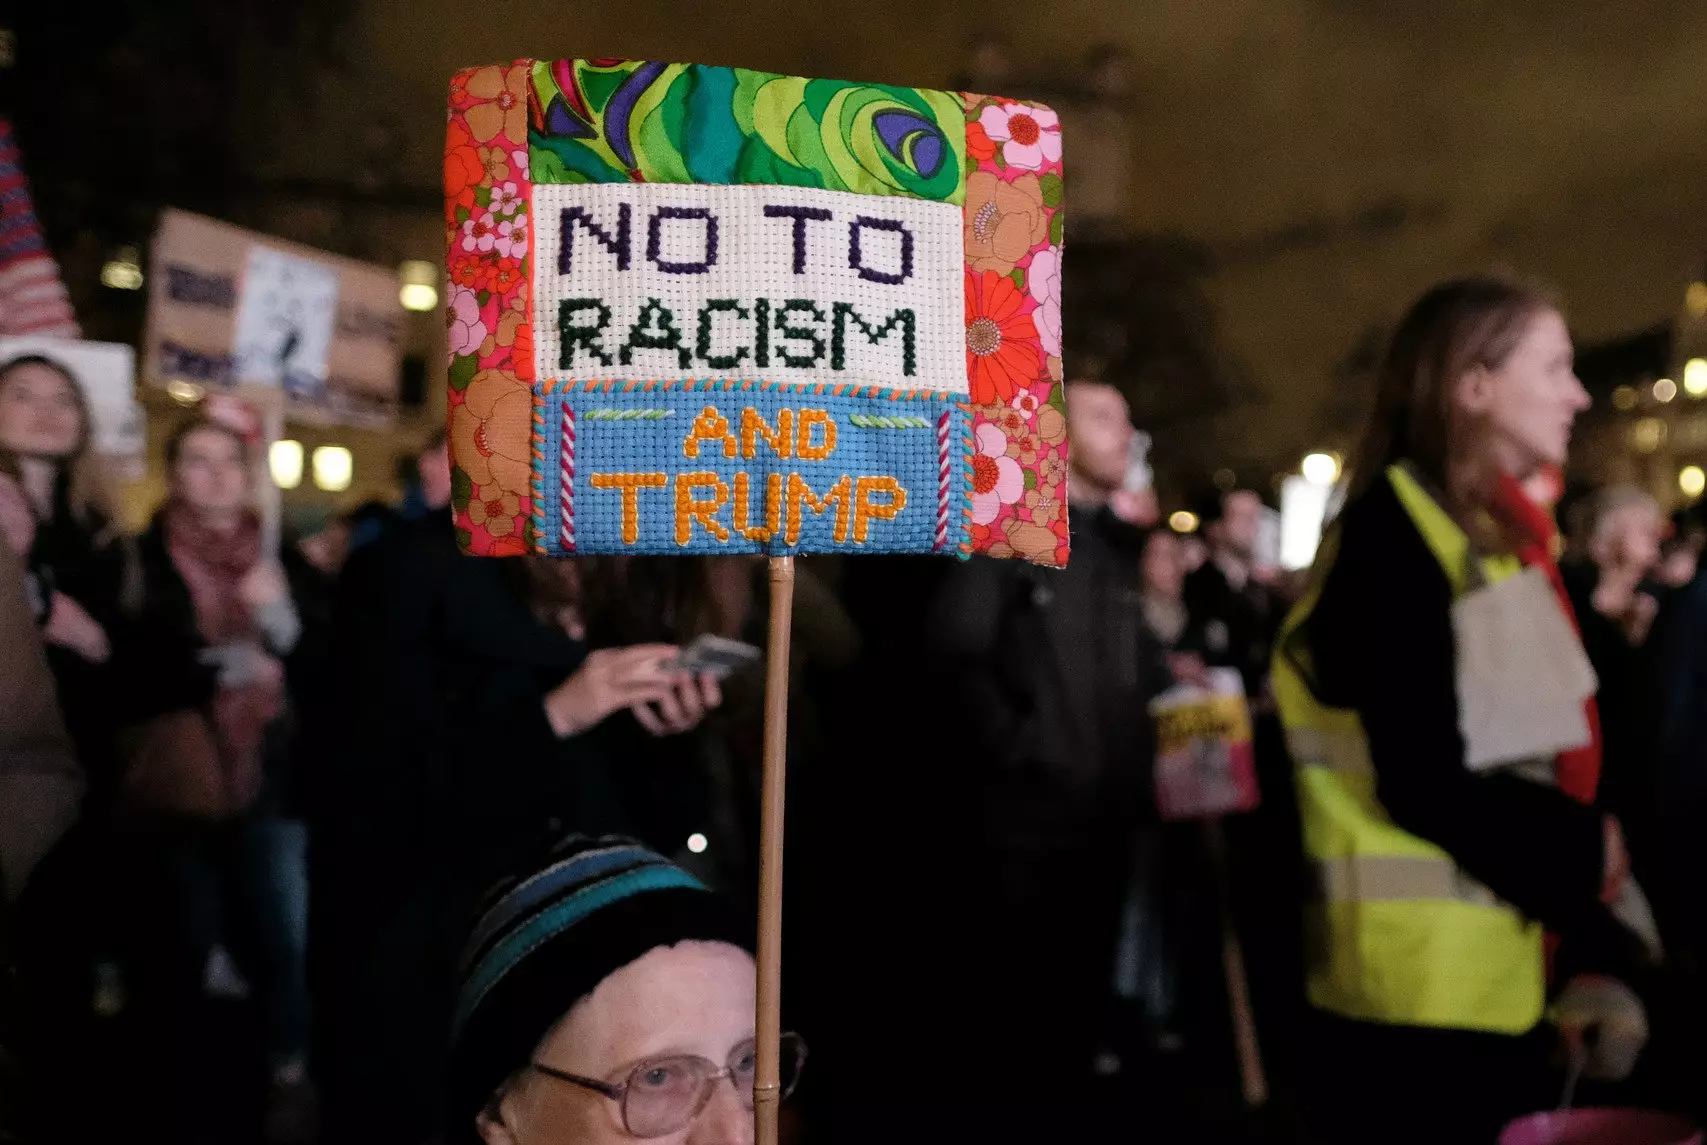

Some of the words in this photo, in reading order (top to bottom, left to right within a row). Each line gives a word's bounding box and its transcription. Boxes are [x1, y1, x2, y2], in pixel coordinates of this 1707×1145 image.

[558, 202, 719, 275] NO
[764, 204, 914, 285] TO
[558, 298, 917, 376] RACISM
[683, 405, 837, 460] AND
[590, 470, 907, 547] TRUMP
